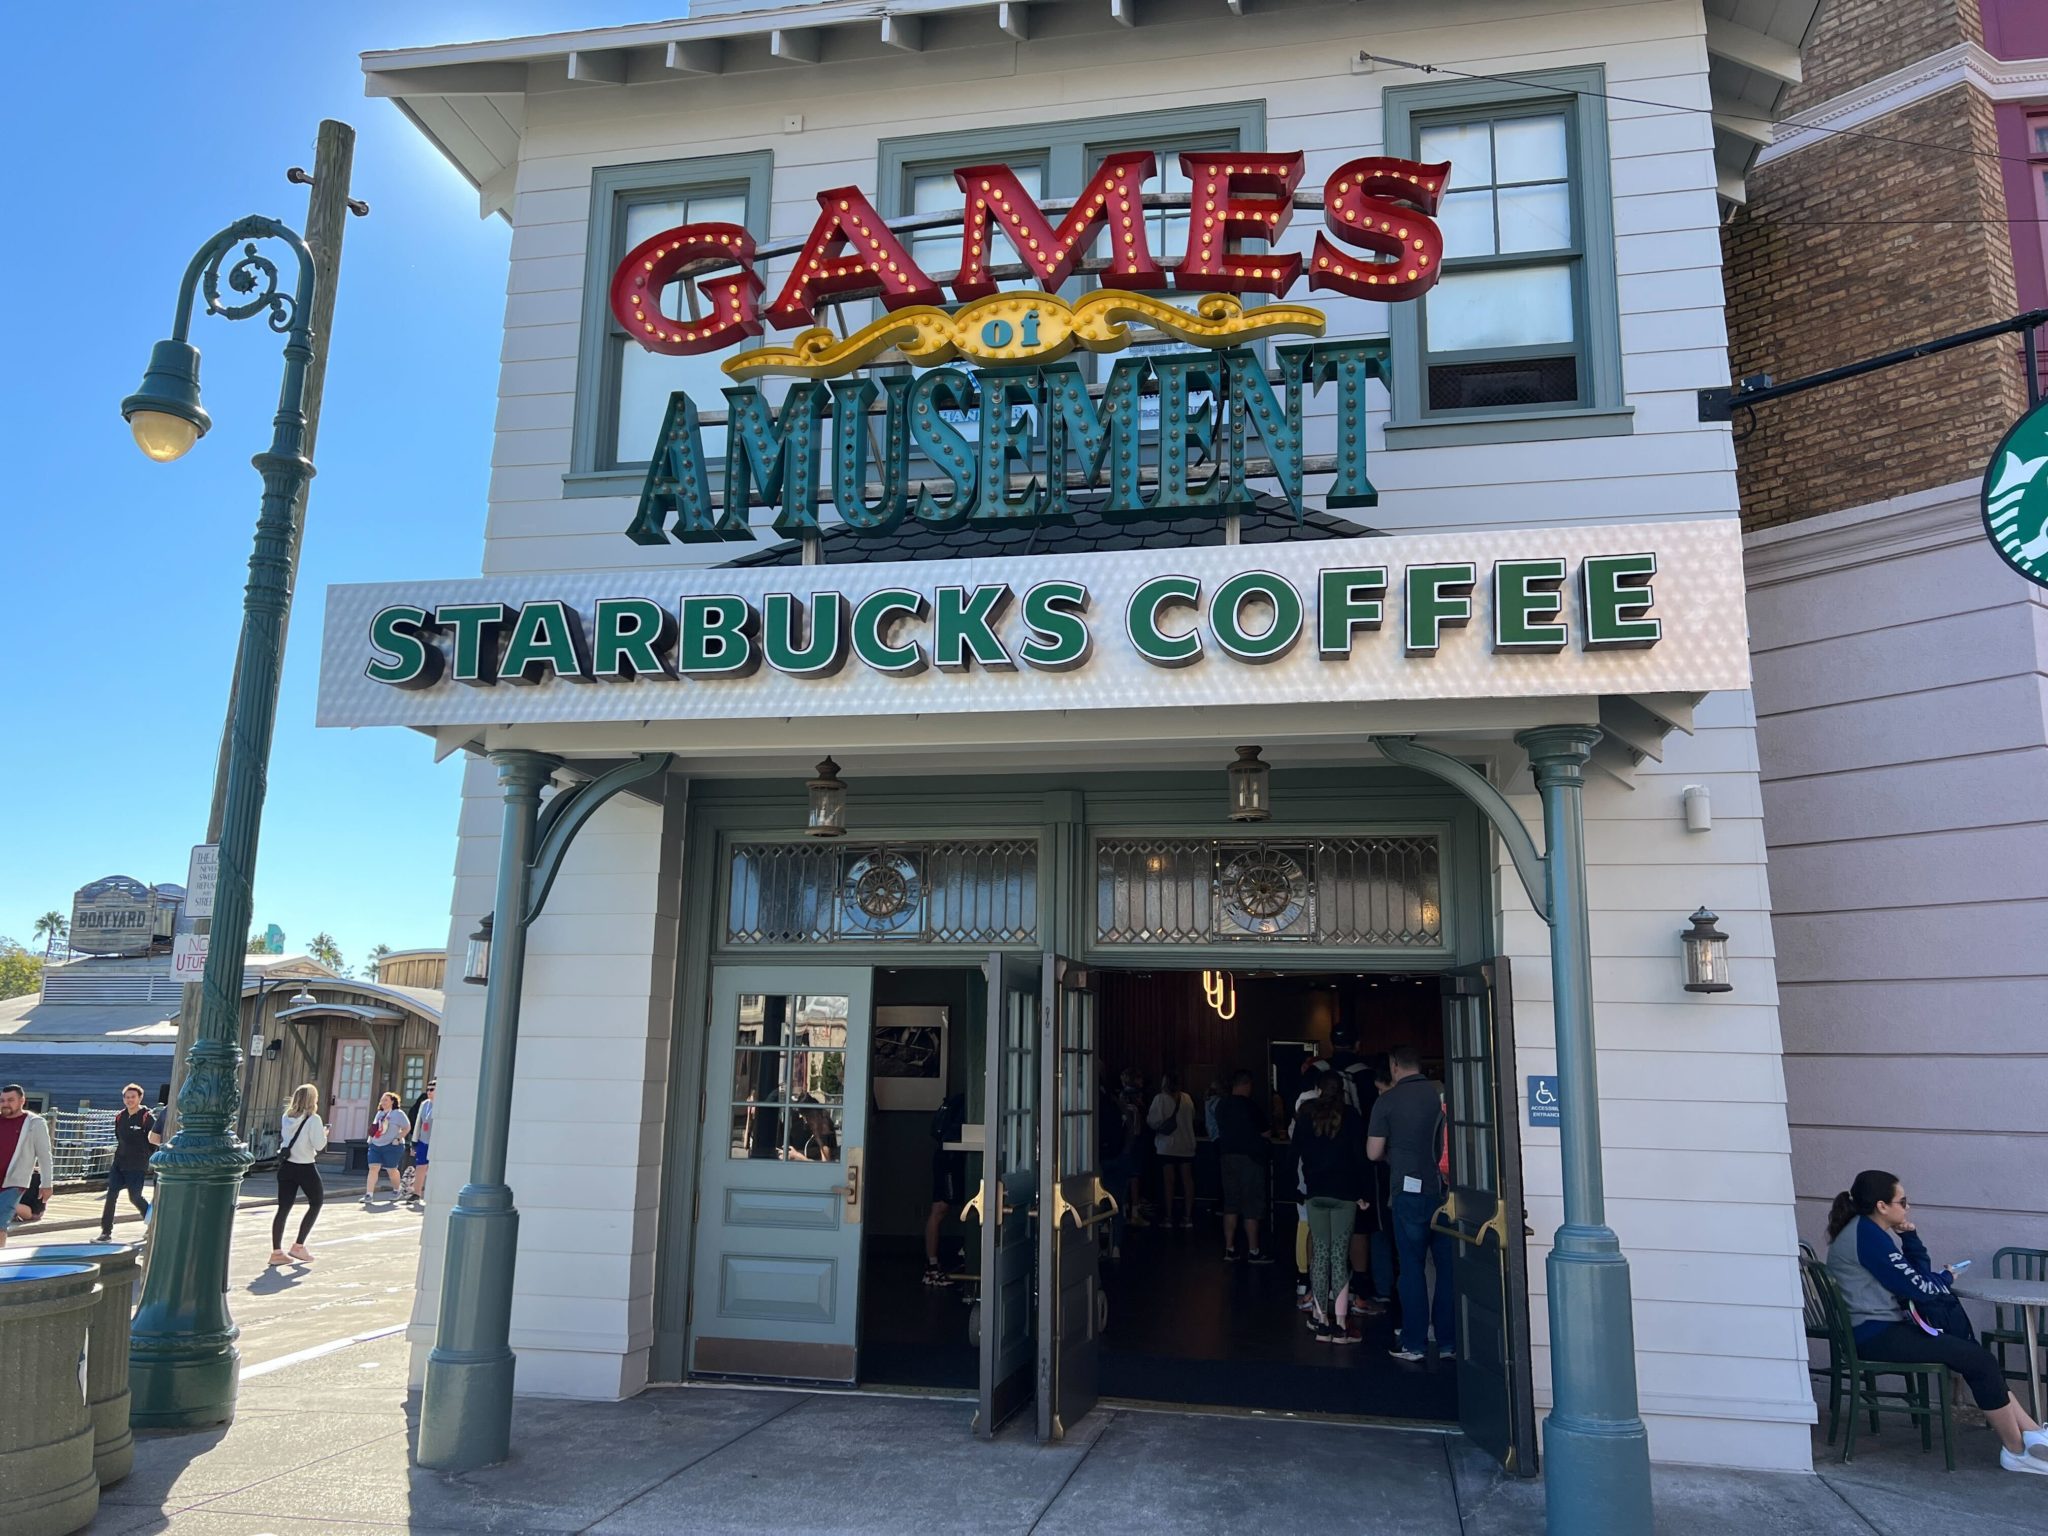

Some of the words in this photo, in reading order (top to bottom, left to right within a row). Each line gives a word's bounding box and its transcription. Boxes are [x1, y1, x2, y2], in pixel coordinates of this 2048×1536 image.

[610, 150, 1451, 355] GAMES
[981, 310, 1041, 348] of
[626, 339, 1391, 544] AMUSEMENT
[365, 580, 1091, 688] STARBUCKS
[1125, 552, 1661, 667] COFFEE
[196, 882, 215, 890] REFUS
[79, 911, 146, 928] BOATYARD
[188, 938, 209, 952] NO
[176, 953, 186, 971] U
[186, 956, 207, 969] TUR
